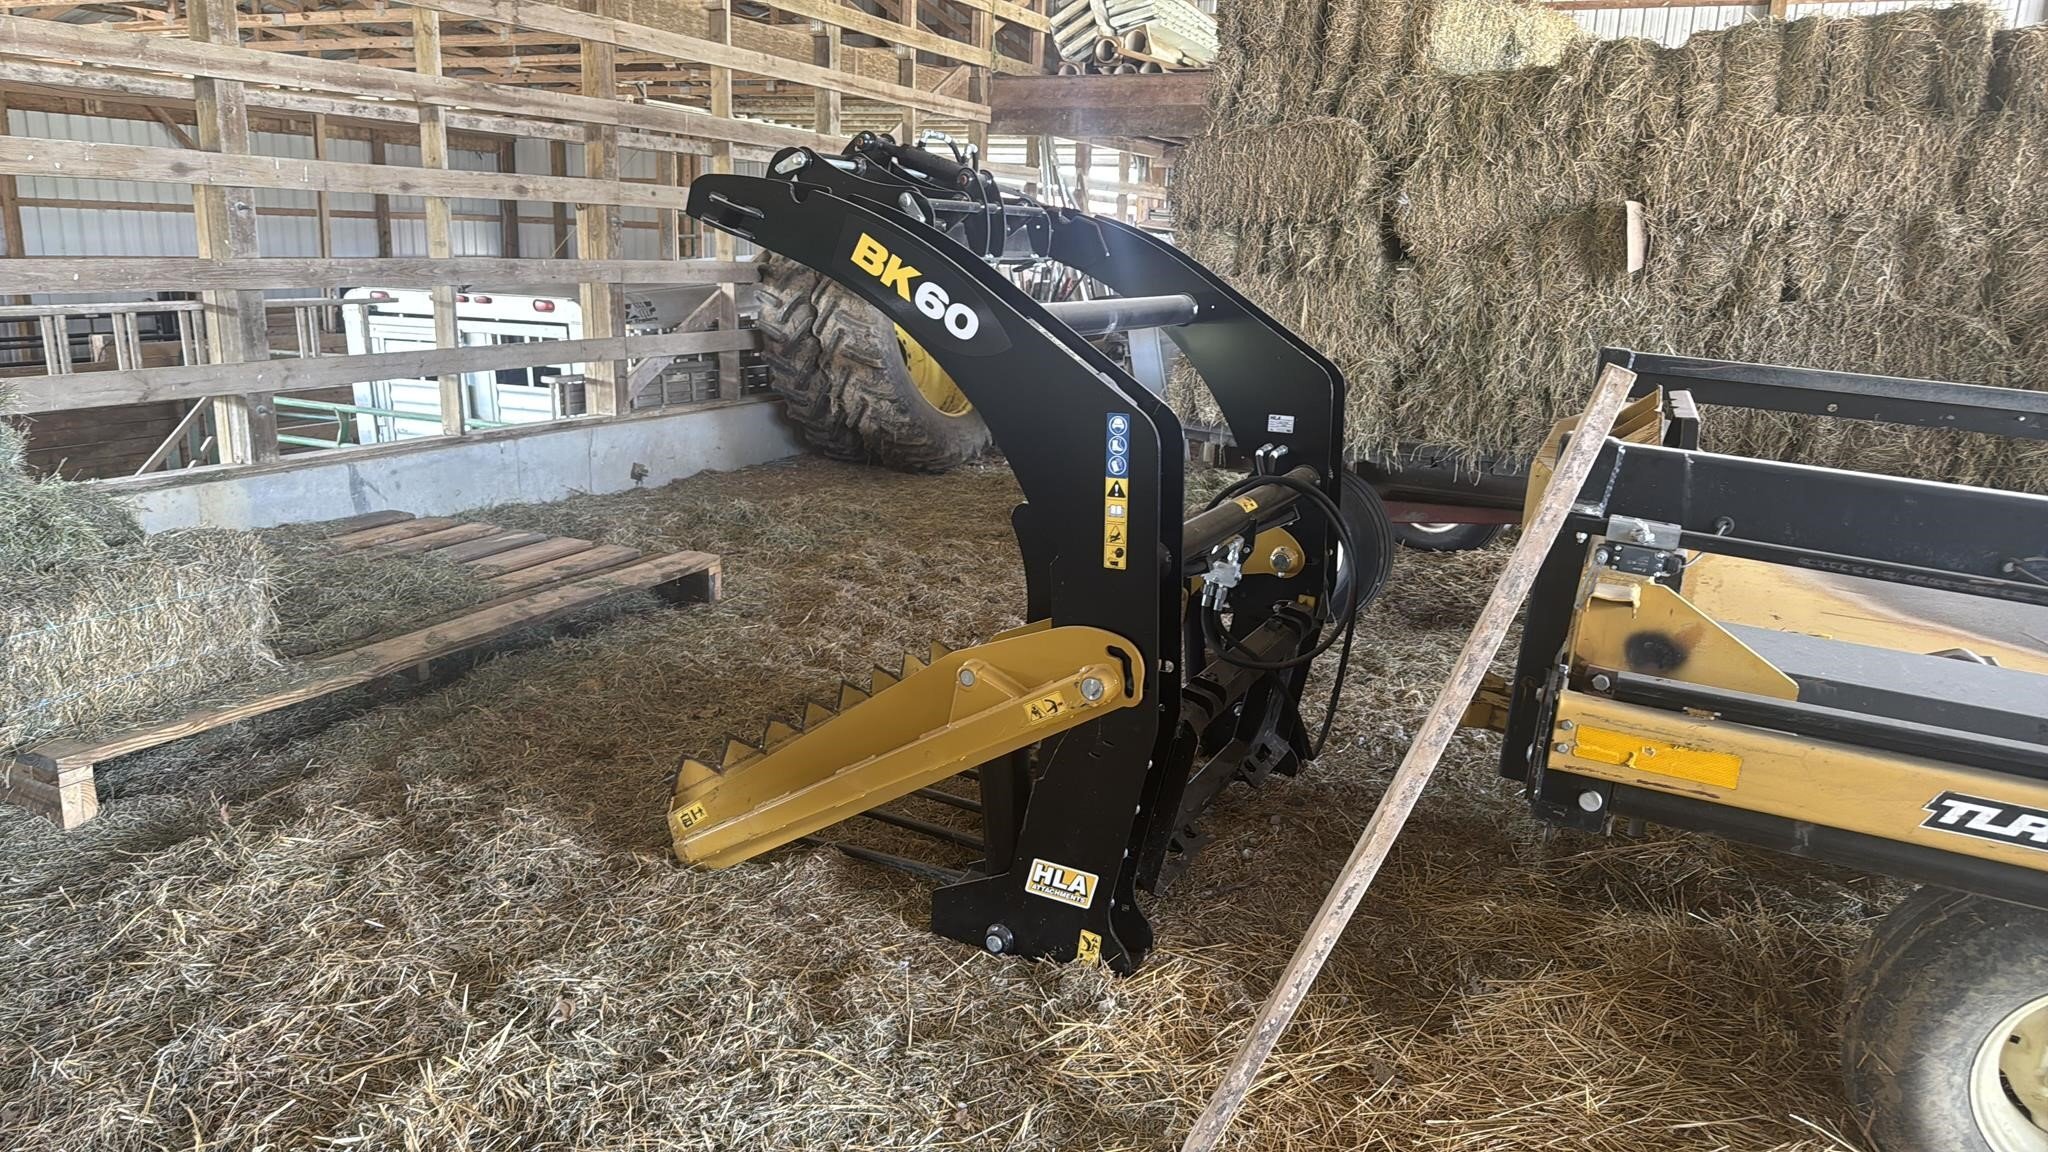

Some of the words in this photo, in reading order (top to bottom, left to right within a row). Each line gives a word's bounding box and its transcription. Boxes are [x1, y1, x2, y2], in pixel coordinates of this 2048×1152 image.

[850, 232, 979, 340] BK60
[1031, 884, 1087, 904] ATTACHMENTS
[1032, 863, 1088, 896] HLA
